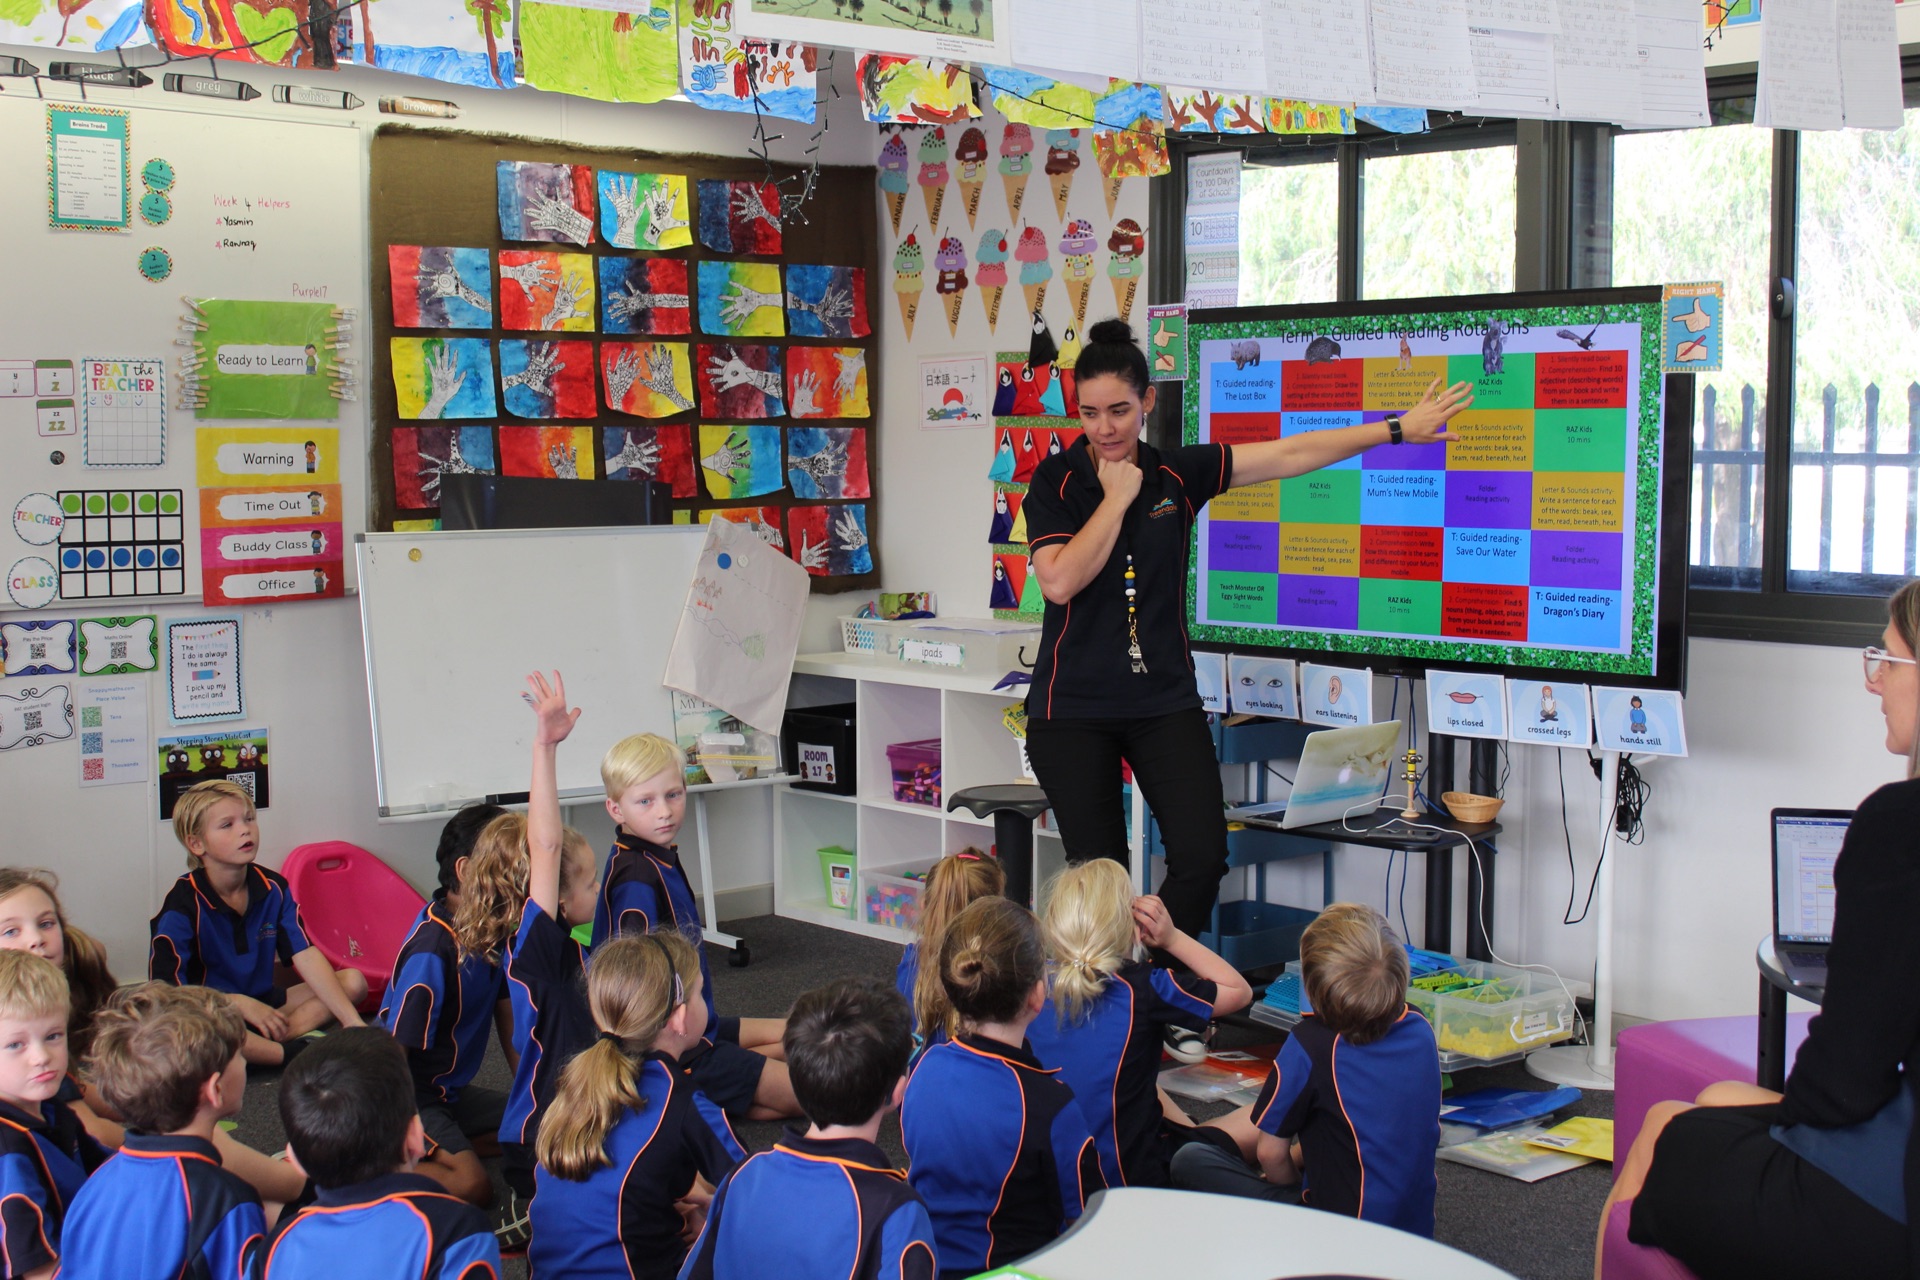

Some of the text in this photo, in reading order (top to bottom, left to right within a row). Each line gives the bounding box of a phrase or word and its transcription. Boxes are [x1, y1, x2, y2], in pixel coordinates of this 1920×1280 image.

[195, 81, 221, 94] grey
[299, 90, 330, 103] white
[402, 101, 435, 113] brown
[1196, 167, 1234, 177] Countdown
[1196, 177, 1234, 188] to 100 Days
[1058, 184, 1069, 202] MAY
[1110, 178, 1122, 201] JUNE
[1199, 190, 1206, 198] of
[213, 194, 291, 211] Week 4 Helpers
[969, 187, 981, 216] MARCH
[1013, 187, 1025, 211] APRIL
[930, 187, 945, 225] FEBRUARY
[223, 216, 254, 226] Yasmin
[1190, 222, 1203, 236] 10
[1191, 261, 1205, 276] 20
[1696, 286, 1716, 295] HAND
[989, 286, 1003, 325] SEPTEMBER
[1077, 282, 1090, 322] NOVEMBER
[1121, 281, 1137, 324] DECEMBER
[906, 304, 916, 322] JULY
[950, 294, 962, 325] AUGUST
[1280, 327, 1314, 344] Term
[1331, 323, 1384, 342] Guided
[1389, 321, 1449, 342] Reading
[1454, 319, 1530, 337] Rotaons
[218, 354, 304, 367] Ready to Learn
[93, 362, 154, 376] BEAT the
[91, 378, 155, 391] TEACHER
[1215, 378, 1276, 389] T: Guided reading-
[1490, 378, 1503, 386] Kids
[1224, 391, 1267, 401] The Lost Box
[1289, 416, 1354, 427] T: Guided reading-
[1579, 425, 1593, 433] Kids
[243, 452, 294, 467] Warning
[1369, 474, 1437, 486] T: Guided reading-
[1367, 488, 1439, 498] Mum's New Mobile
[244, 500, 301, 511] Time Out
[17, 510, 62, 527] TEACHER
[1451, 532, 1523, 546] T: Guided reading-
[233, 540, 308, 553] Buddy Class
[1456, 546, 1517, 558] Save Our Water
[12, 575, 54, 590] CLASS
[258, 579, 296, 590] Office
[1233, 593, 1246, 601] Sight
[1535, 591, 1614, 607] T: Guided reading-
[1543, 606, 1605, 620] Dragon's Diary
[204, 651, 228, 660] always
[921, 646, 943, 660] ipads
[191, 684, 204, 692] pick
[216, 683, 227, 691] my
[189, 691, 224, 701] pencil and
[680, 699, 696, 710] MY
[1245, 700, 1284, 712] eyes looking
[1315, 709, 1358, 723] ears listening
[1447, 717, 1484, 728] lips closed
[1527, 726, 1572, 737] crossed legs
[204, 734, 224, 743] Stones
[1620, 735, 1662, 746] hands still
[804, 750, 828, 762] ROOM
[812, 766, 822, 776] 17
